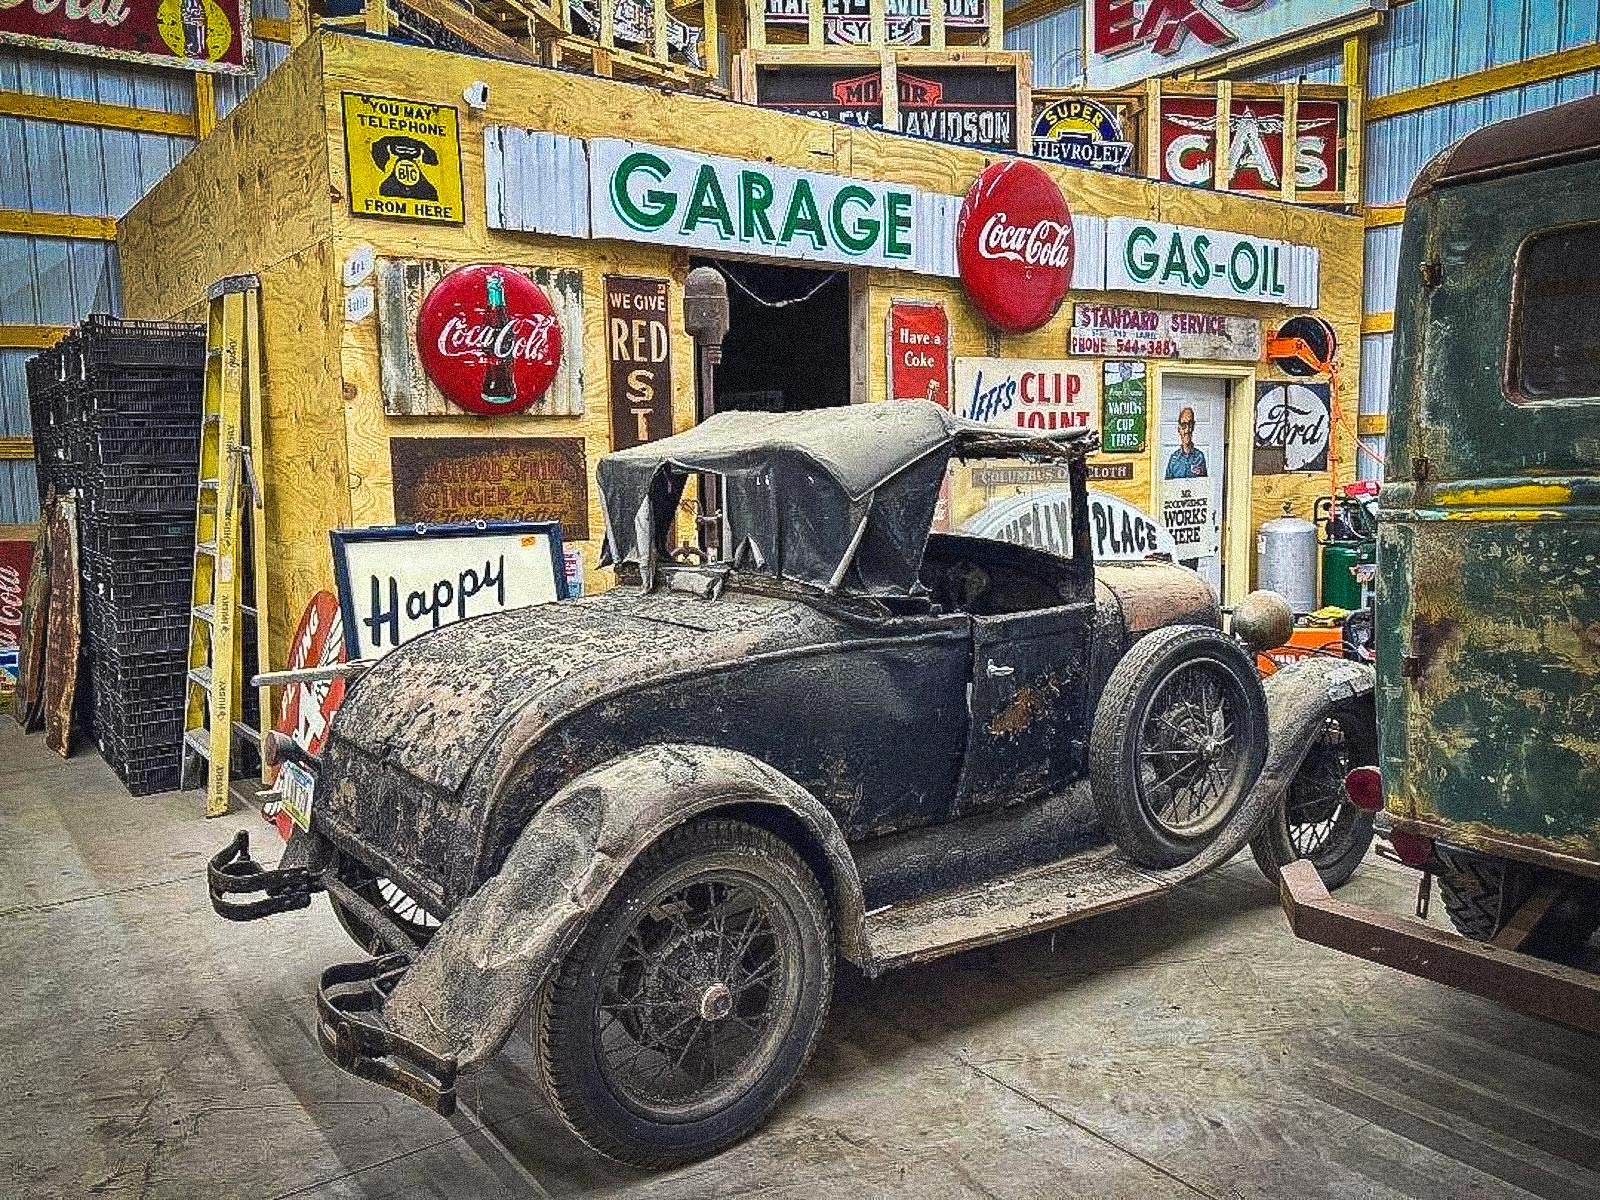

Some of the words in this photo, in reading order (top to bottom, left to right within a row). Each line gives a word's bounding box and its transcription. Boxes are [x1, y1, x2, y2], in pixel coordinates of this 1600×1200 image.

[846, 81, 927, 102] MOOR
[357, 113, 447, 137] TELEPHONE
[1046, 103, 1103, 127] SUPER
[1165, 105, 1329, 188] GAS
[364, 199, 407, 214] FROM
[414, 203, 454, 219] HERE
[609, 152, 913, 260] GARAGE
[1122, 226, 1286, 297] GAS-OIL
[609, 292, 631, 309] WE
[634, 294, 667, 311] GIVE
[1081, 307, 1160, 331] STANDARD
[1171, 313, 1226, 336] SERVICE
[611, 317, 669, 363] RED
[899, 327, 930, 345] Have
[932, 335, 942, 345] a
[1072, 336, 1107, 354] PHONE
[904, 350, 935, 368] Coke
[1020, 371, 1081, 404] CLIP
[1116, 418, 1135, 432] CUP
[1256, 404, 1325, 446] Ford
[1110, 433, 1139, 448] TIRES
[1091, 501, 1159, 556] PLACE
[1163, 507, 1208, 528] WORKS
[362, 554, 505, 647] Happy
